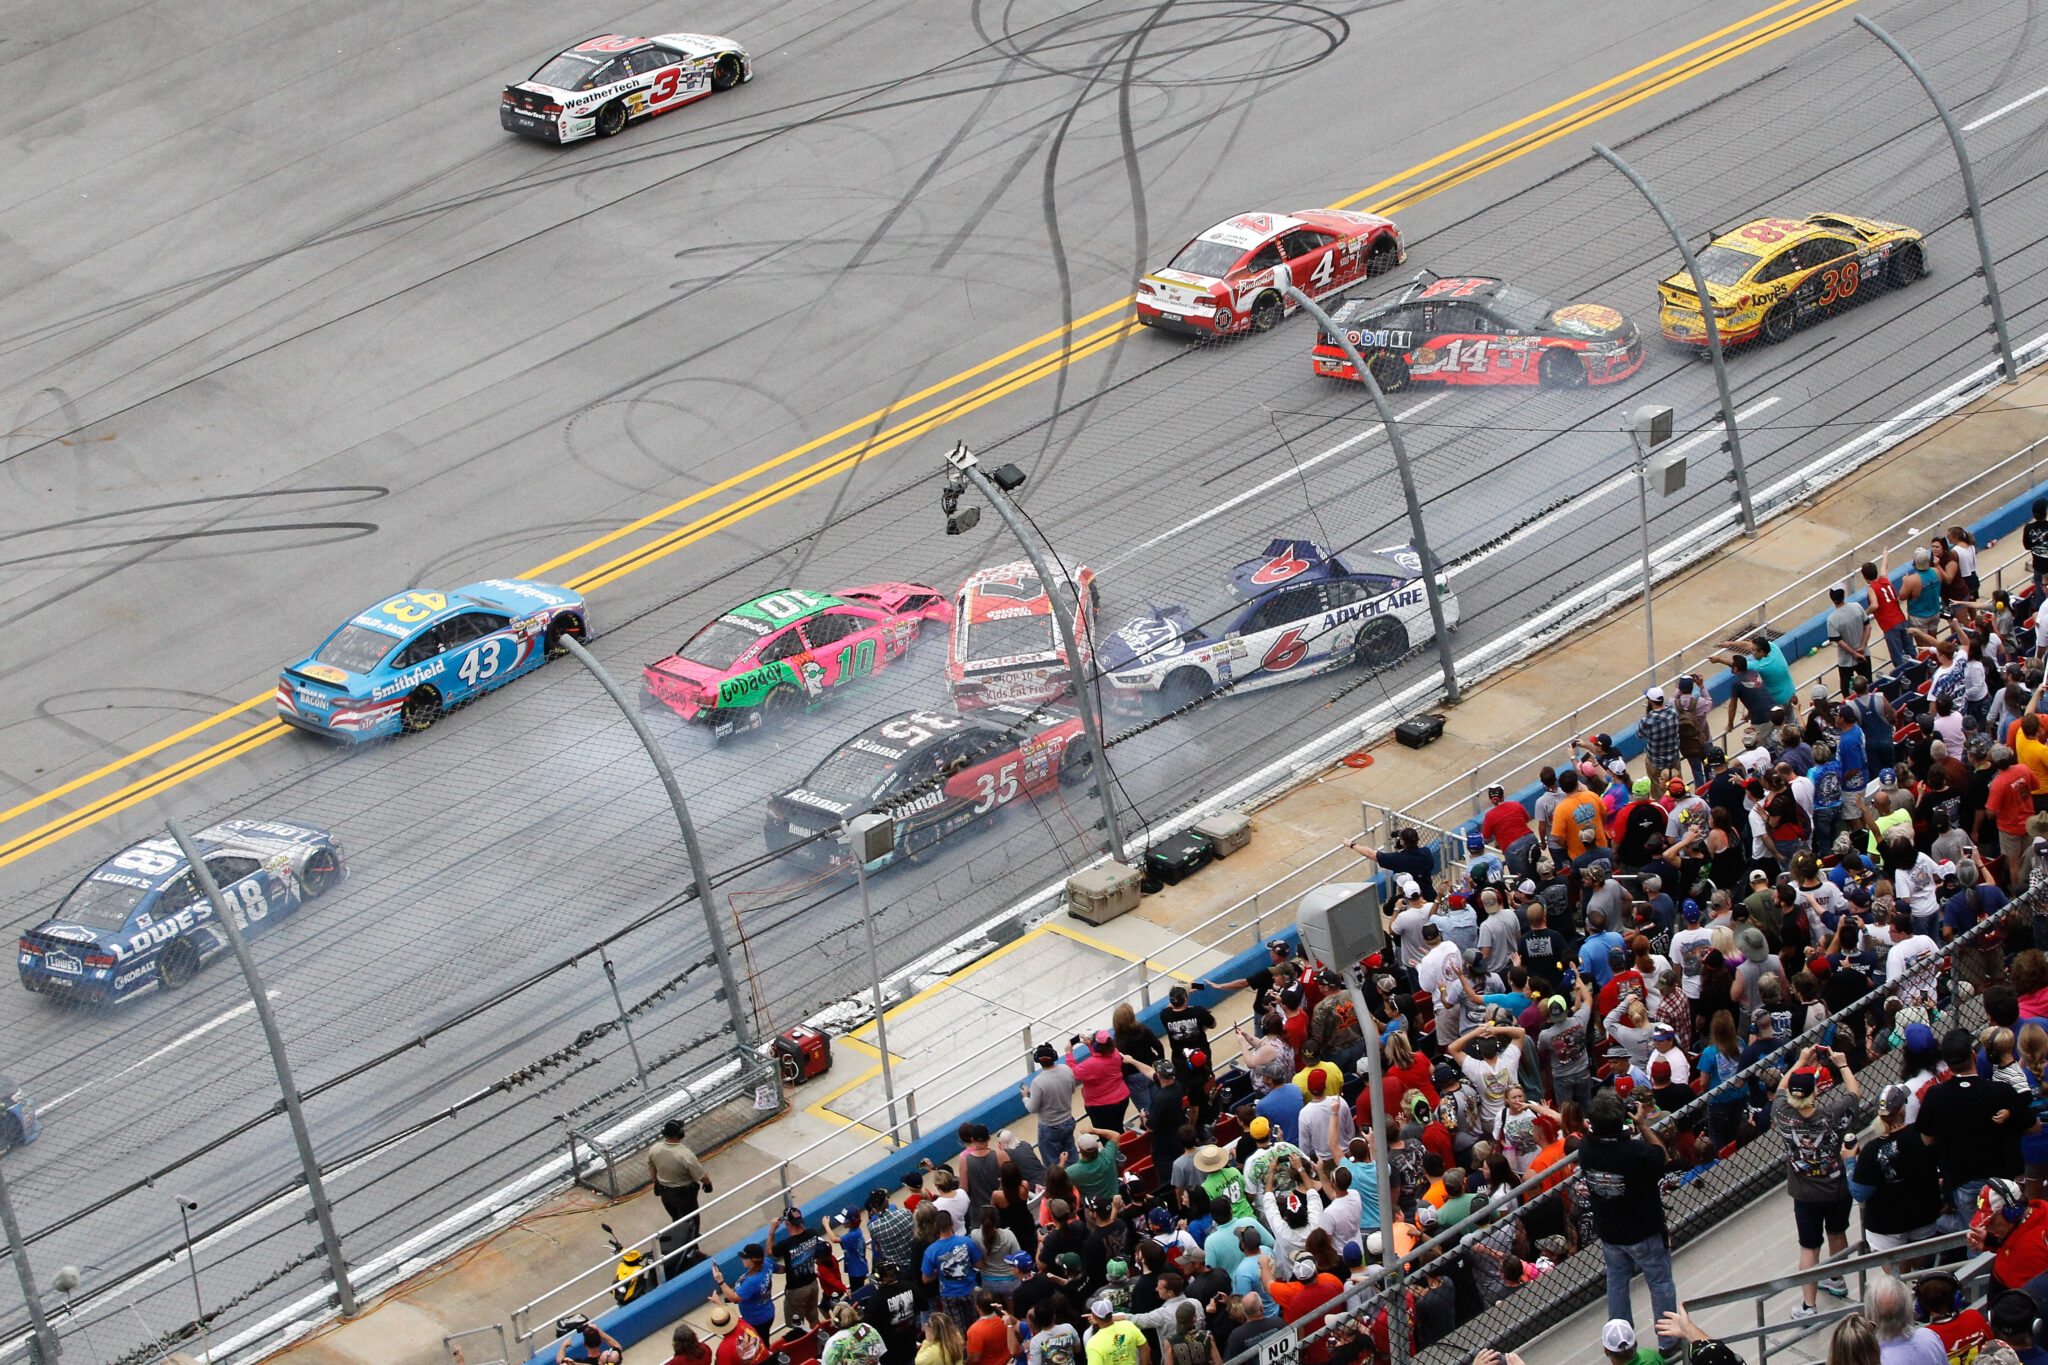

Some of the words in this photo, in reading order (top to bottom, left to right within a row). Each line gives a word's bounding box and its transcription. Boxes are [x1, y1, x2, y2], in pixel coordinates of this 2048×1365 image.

[564, 79, 640, 109] WeatherTech
[649, 67, 681, 105] 3
[514, 107, 546, 120] WeatherTech
[1226, 214, 1274, 236] 4
[1309, 249, 1335, 289] 4
[1819, 261, 1859, 306] 38
[1441, 339, 1489, 373] 14
[1251, 541, 1310, 585] 6
[382, 591, 449, 623] 43
[756, 590, 821, 620] 10
[1322, 588, 1423, 630] ADVOCARE
[1880, 585, 1896, 603] 11
[457, 639, 502, 687] 43
[833, 638, 877, 687] 10
[1260, 623, 1310, 672] 6
[372, 660, 447, 702] Smithfield
[720, 663, 784, 703] GoDaddy
[850, 738, 908, 760] Rinnai
[783, 788, 852, 815] Rinnai
[974, 760, 1019, 815] 35
[829, 854, 841, 866] 35
[109, 900, 213, 963] LOWE'S
[50, 955, 78, 972] LOWE'S
[123, 960, 157, 985] KOBALT
[1268, 1338, 1289, 1360] NO
